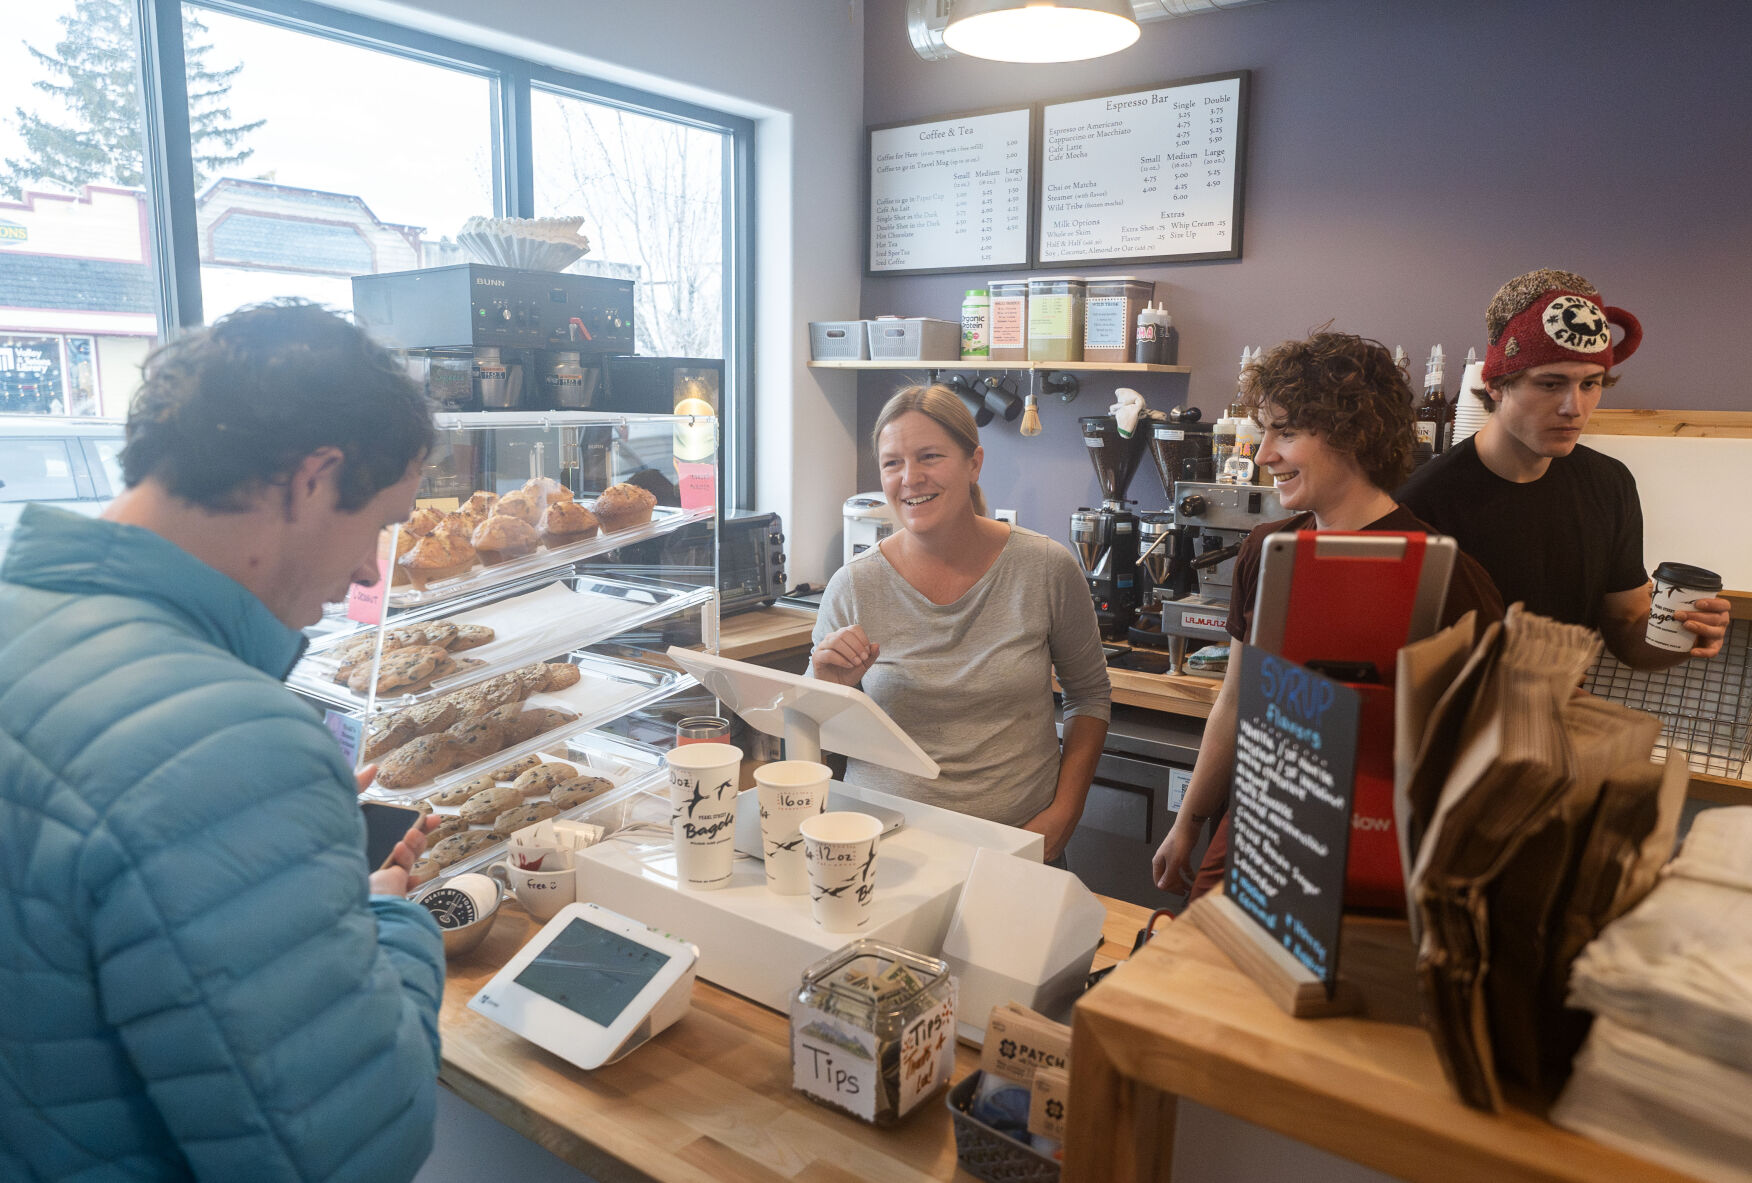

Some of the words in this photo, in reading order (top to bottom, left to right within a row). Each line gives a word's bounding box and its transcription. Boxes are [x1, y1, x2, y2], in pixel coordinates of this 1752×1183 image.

[1107, 97, 1148, 112] Espresso
[1151, 94, 1168, 104] Bar
[1173, 100, 1195, 110] Single
[1204, 95, 1230, 105] Double
[1210, 107, 1224, 115] 3.75
[920, 130, 945, 140] Coffee
[948, 128, 955, 136] &
[958, 126, 974, 135] Tea
[1049, 127, 1076, 136] Espresso
[1087, 121, 1122, 130] Americano
[1049, 134, 1086, 144] Cappuccino
[1096, 129, 1131, 138] Macchiato
[1177, 131, 1190, 139] 4.75
[877, 153, 894, 161] Coffee
[1066, 151, 1087, 159] Mocha
[1140, 155, 1160, 164] Small
[1167, 152, 1198, 161] Medium
[1204, 148, 1225, 157] Large
[877, 165, 894, 173] Coffee
[917, 161, 934, 169] Travel
[976, 169, 1000, 177] Medium
[1073, 180, 1097, 189] Matcha
[1066, 202, 1083, 210] Tribe
[876, 215, 892, 223] Single
[1161, 211, 1185, 219] Extras
[1072, 219, 1100, 228] Options
[1171, 222, 1190, 230] Whip
[1075, 229, 1091, 237] Skim
[1186, 231, 1196, 239] Up
[1121, 235, 1141, 243] Flavor
[476, 278, 505, 287] BUNN
[1554, 328, 1608, 348] GRIND
[1261, 656, 1335, 726] SYRUP
[527, 879, 547, 889] Free
[424, 891, 445, 903] DEATH
[909, 1014, 942, 1047] Tips
[1019, 1044, 1065, 1069] PATCH
[802, 1044, 860, 1094] Tips
